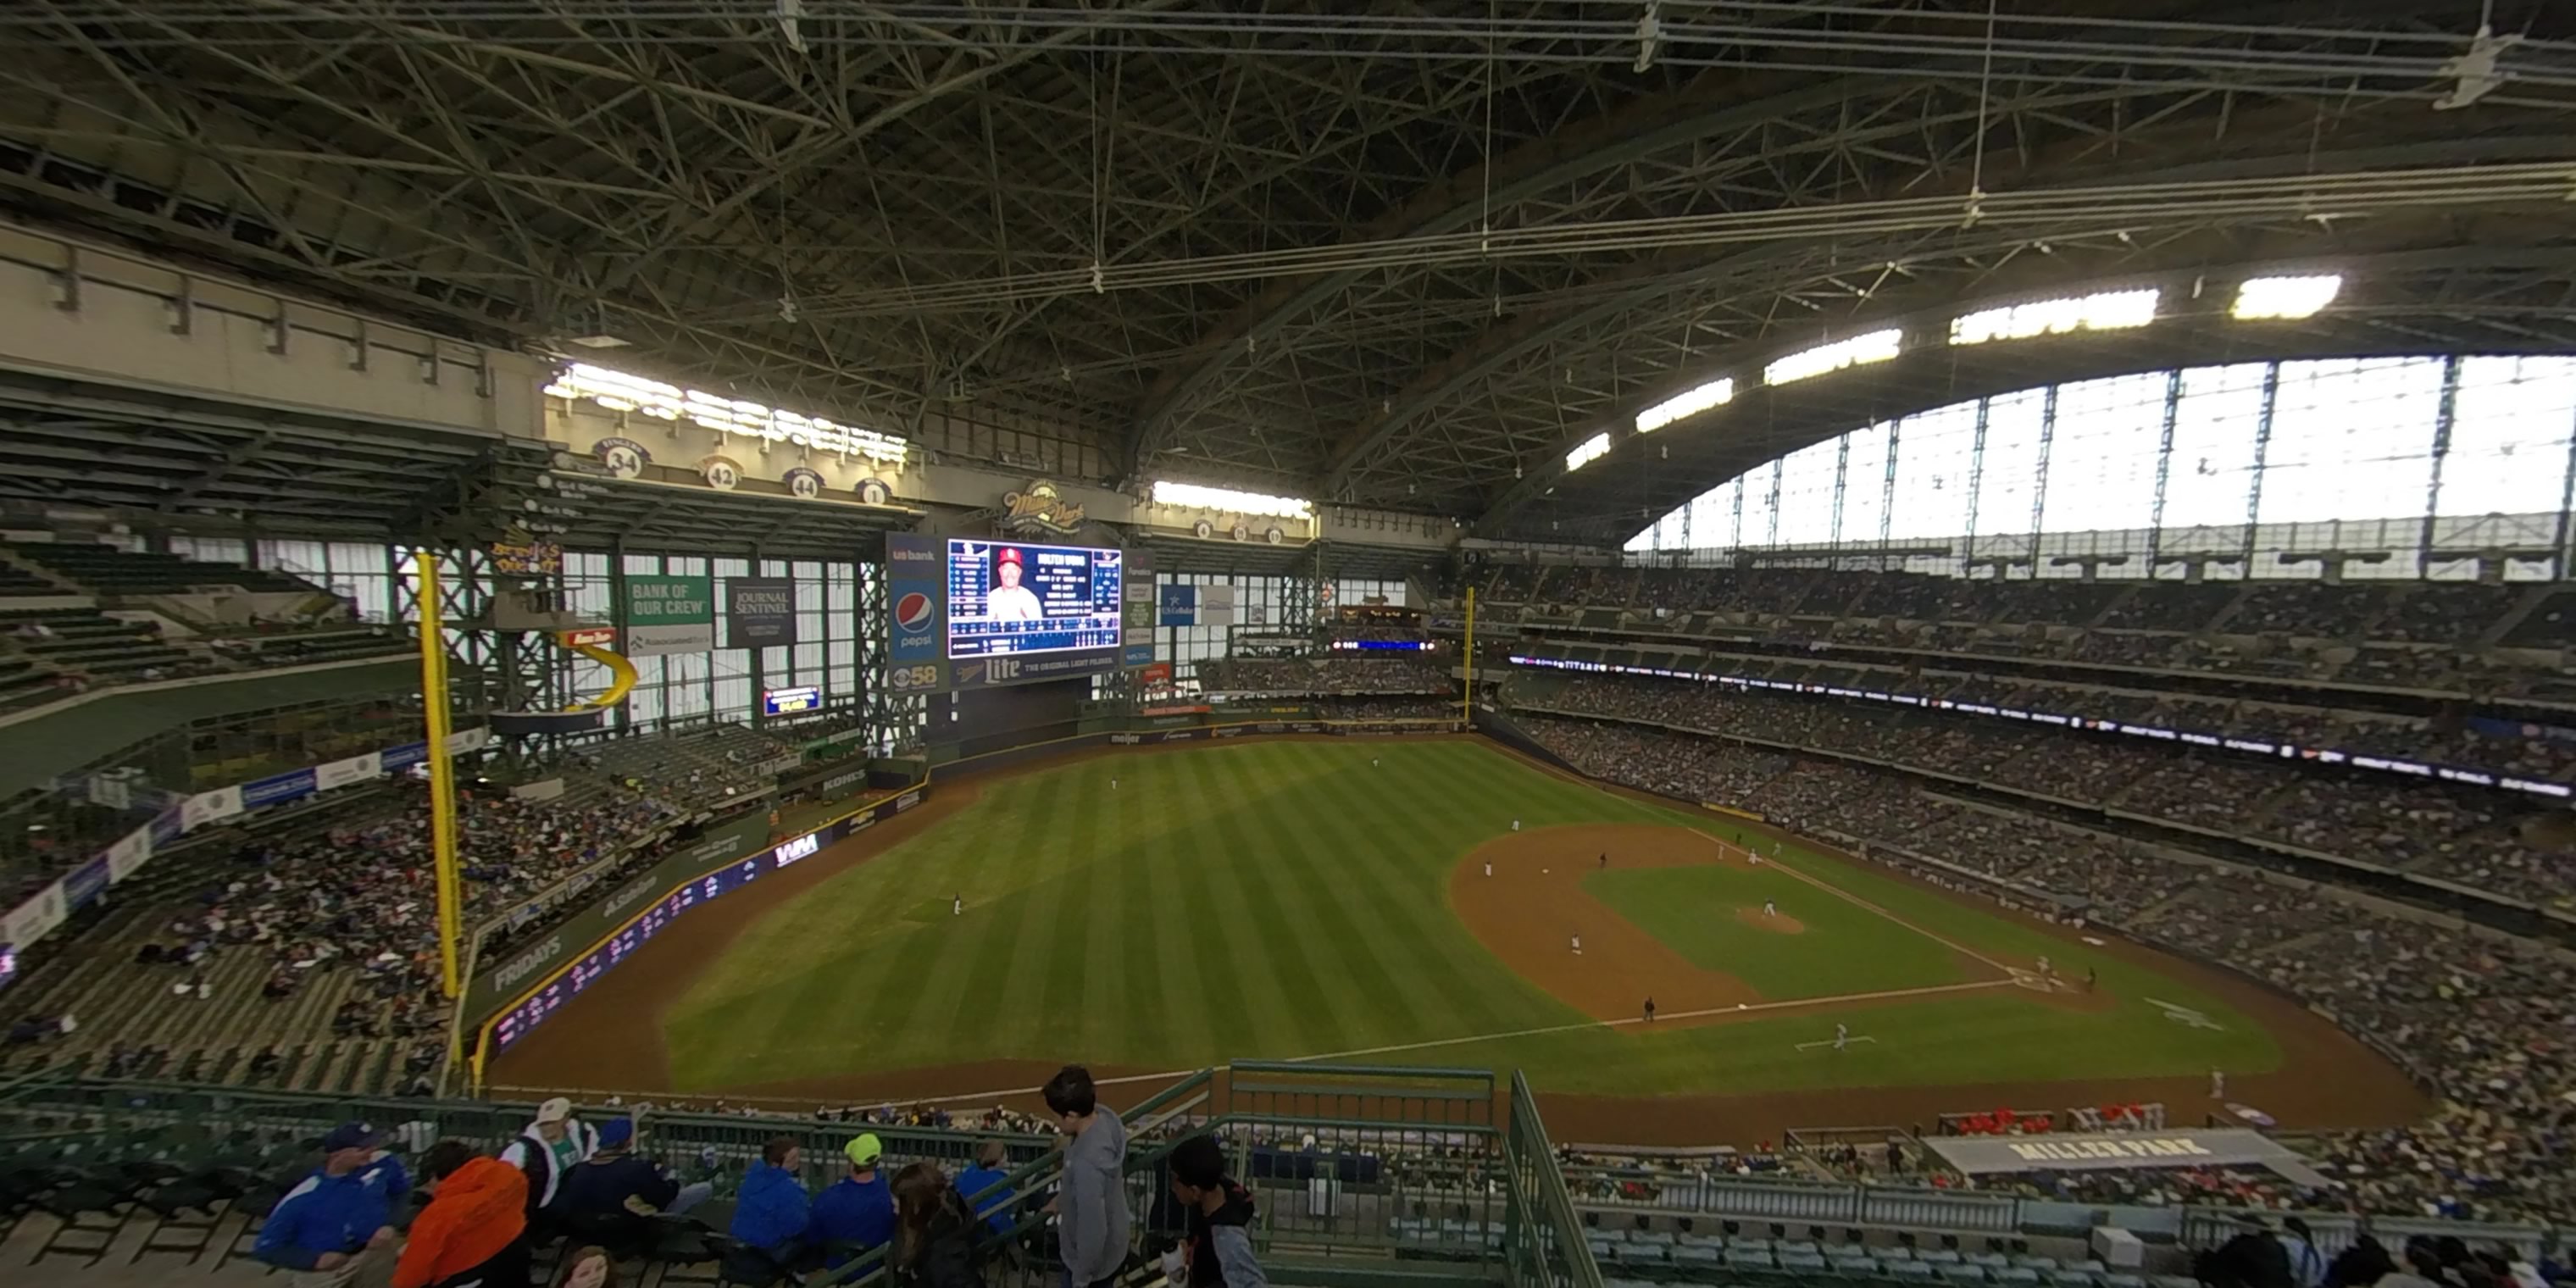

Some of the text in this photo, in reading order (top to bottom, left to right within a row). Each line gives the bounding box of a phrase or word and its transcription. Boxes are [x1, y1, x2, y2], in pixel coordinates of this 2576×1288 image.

[609, 452, 636, 473] 34
[711, 468, 734, 486] 42
[796, 479, 814, 495] 44
[632, 584, 690, 600] BANK OF
[736, 591, 790, 604] JOURNAL
[634, 599, 704, 616] OUR CREW
[735, 602, 790, 615] SENTINEL
[901, 635, 932, 649] pepsi
[984, 658, 1021, 685] Lite
[1024, 663, 1039, 672] THE
[1040, 660, 1069, 671] ORIGINAL
[910, 665, 937, 686] 58
[1111, 731, 1141, 745] meijer
[494, 935, 562, 992] FRIDAYS
[2007, 1137, 2212, 1161] MILLER PARK
